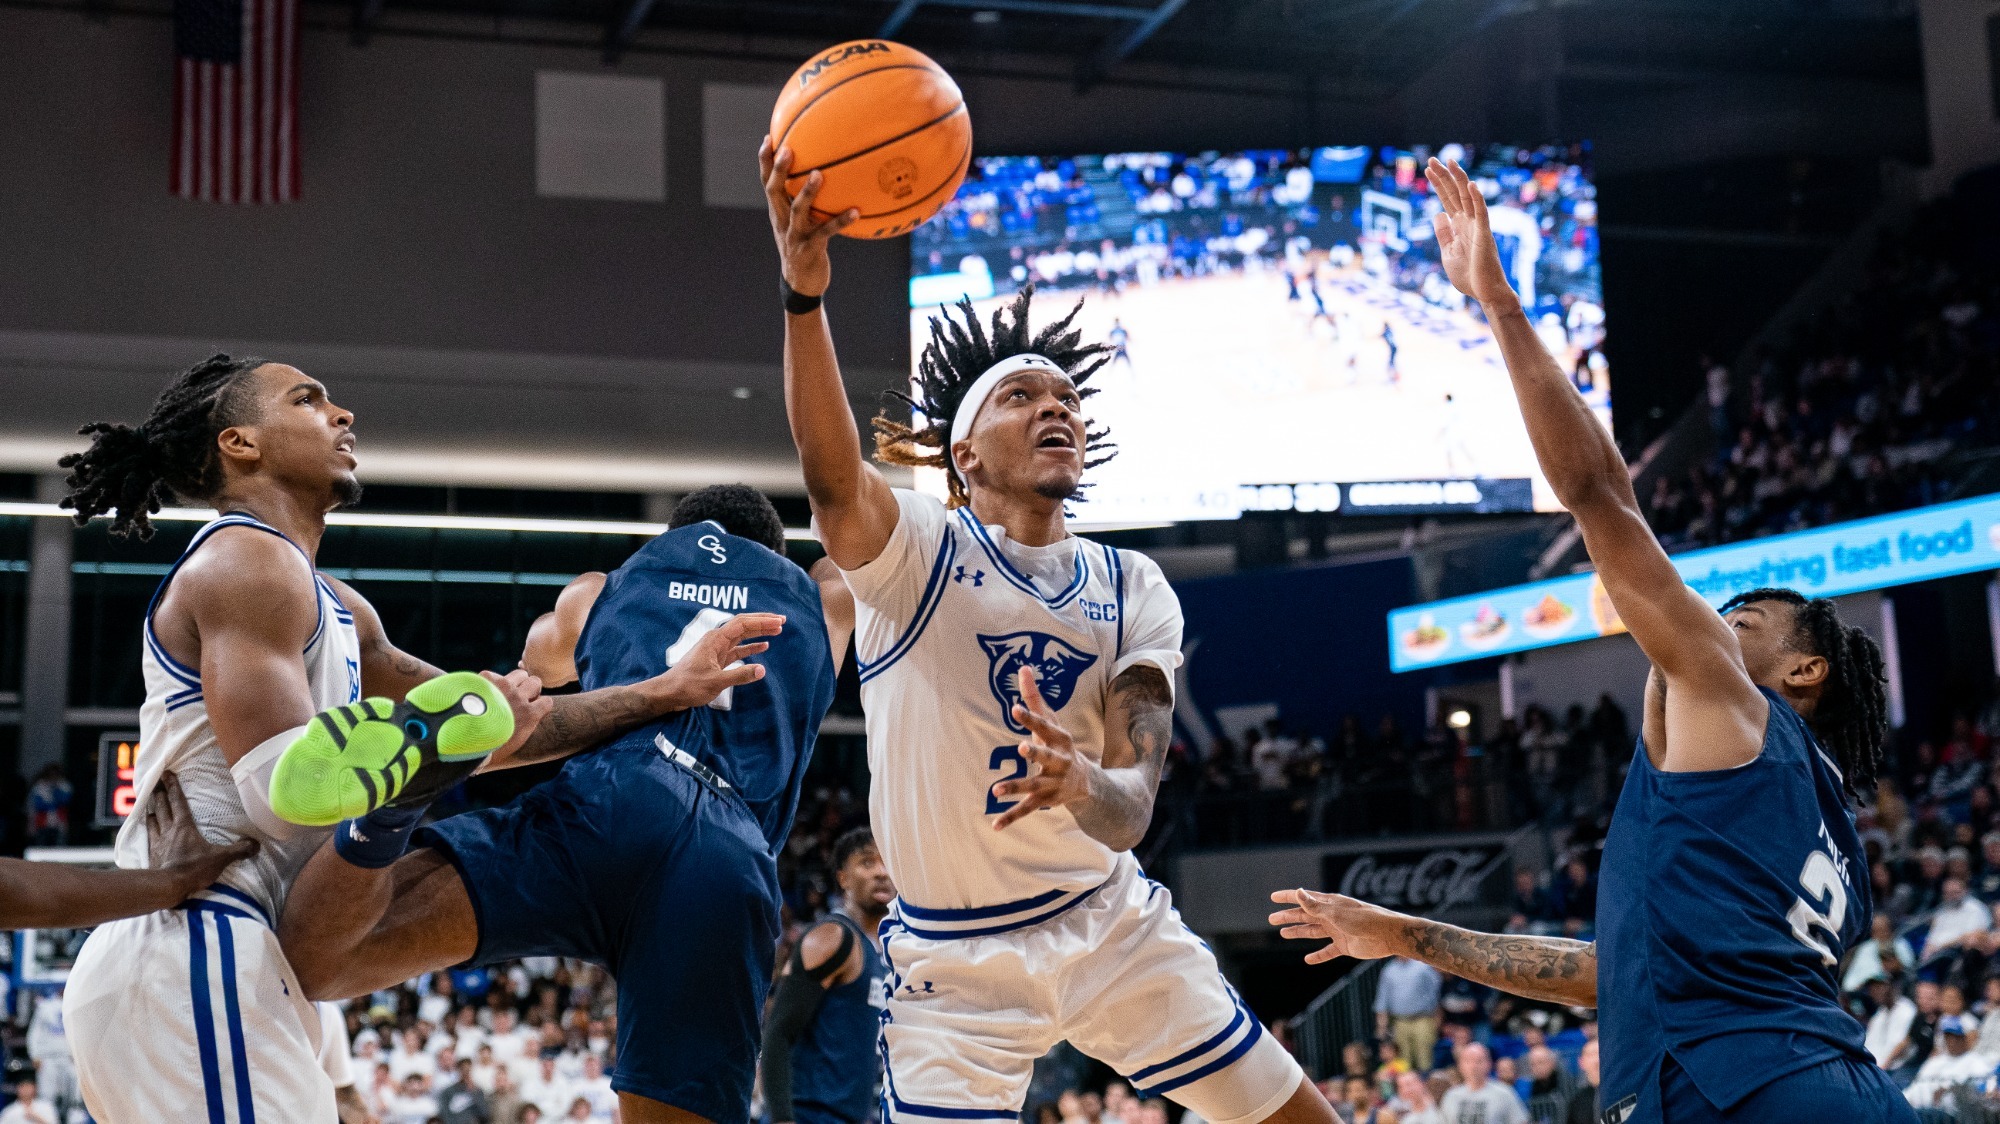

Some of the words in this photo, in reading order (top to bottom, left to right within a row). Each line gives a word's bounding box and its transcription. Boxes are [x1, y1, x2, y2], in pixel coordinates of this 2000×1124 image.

[798, 42, 891, 88] NCAA
[697, 535, 727, 564] GS
[1684, 552, 1825, 594] efreshing
[1832, 537, 1891, 574] fast
[1899, 519, 1974, 562] food
[668, 581, 749, 610] BROWN
[1079, 597, 1117, 622] SBC
[1786, 850, 1848, 966] 2
